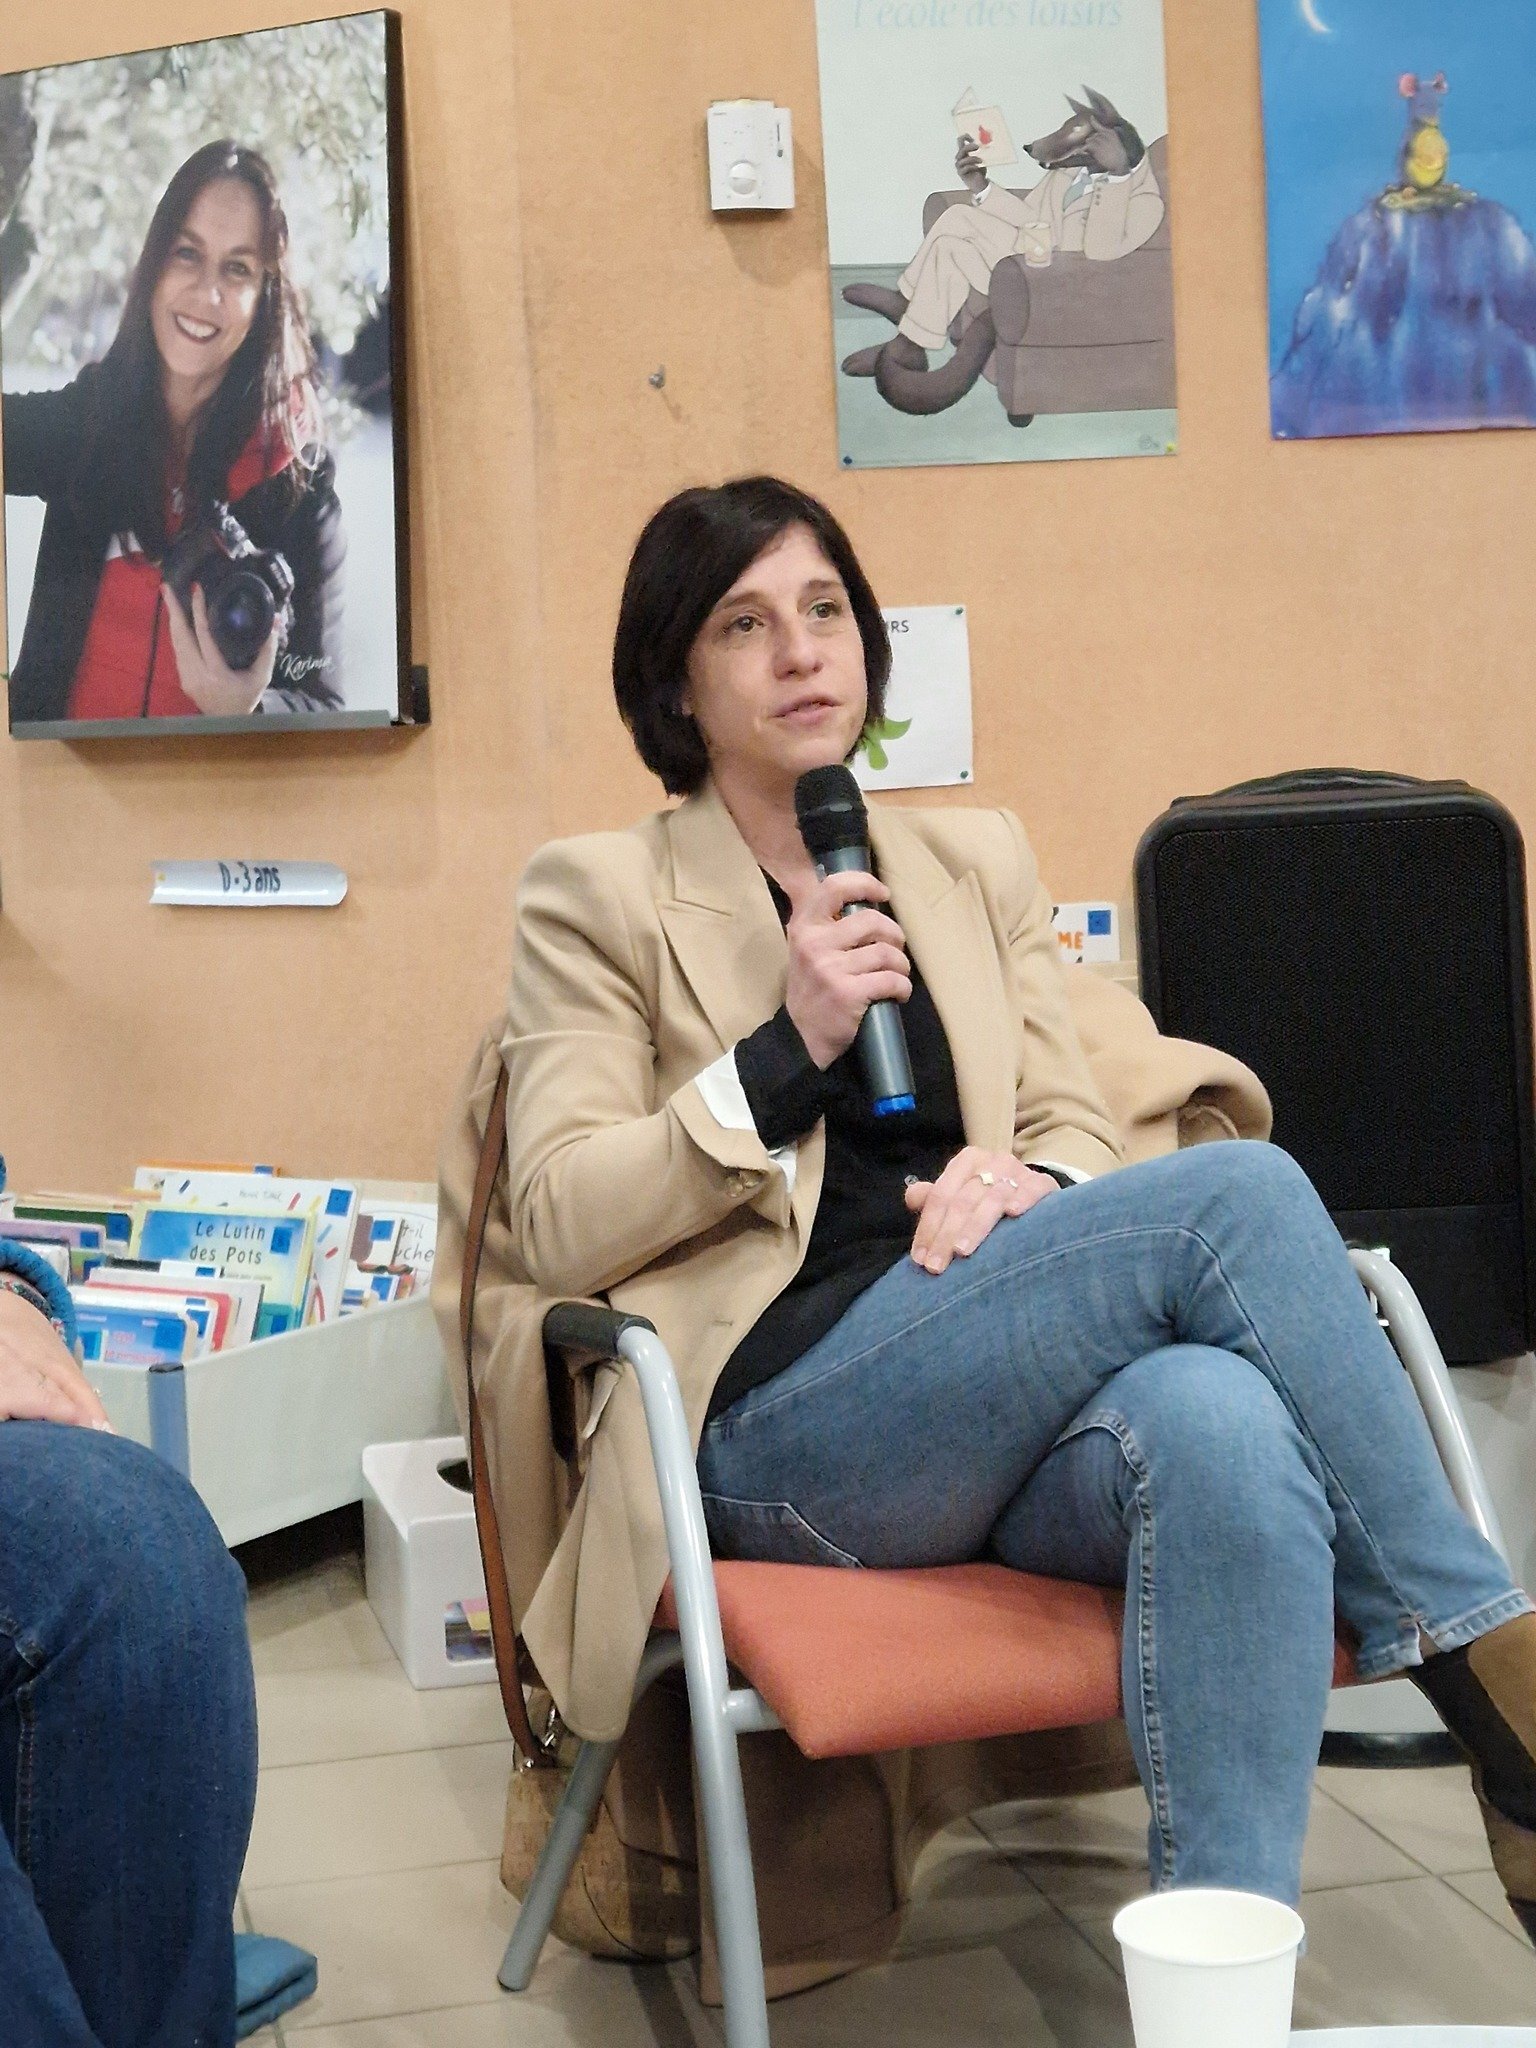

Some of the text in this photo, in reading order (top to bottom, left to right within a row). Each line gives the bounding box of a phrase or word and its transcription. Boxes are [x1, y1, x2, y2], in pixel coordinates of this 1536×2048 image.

[854, 0, 1123, 27] lécole des loisirs
[888, 619, 910, 633] RS
[195, 1221, 265, 1240] Le Lutin
[190, 1245, 262, 1265] des Pots
